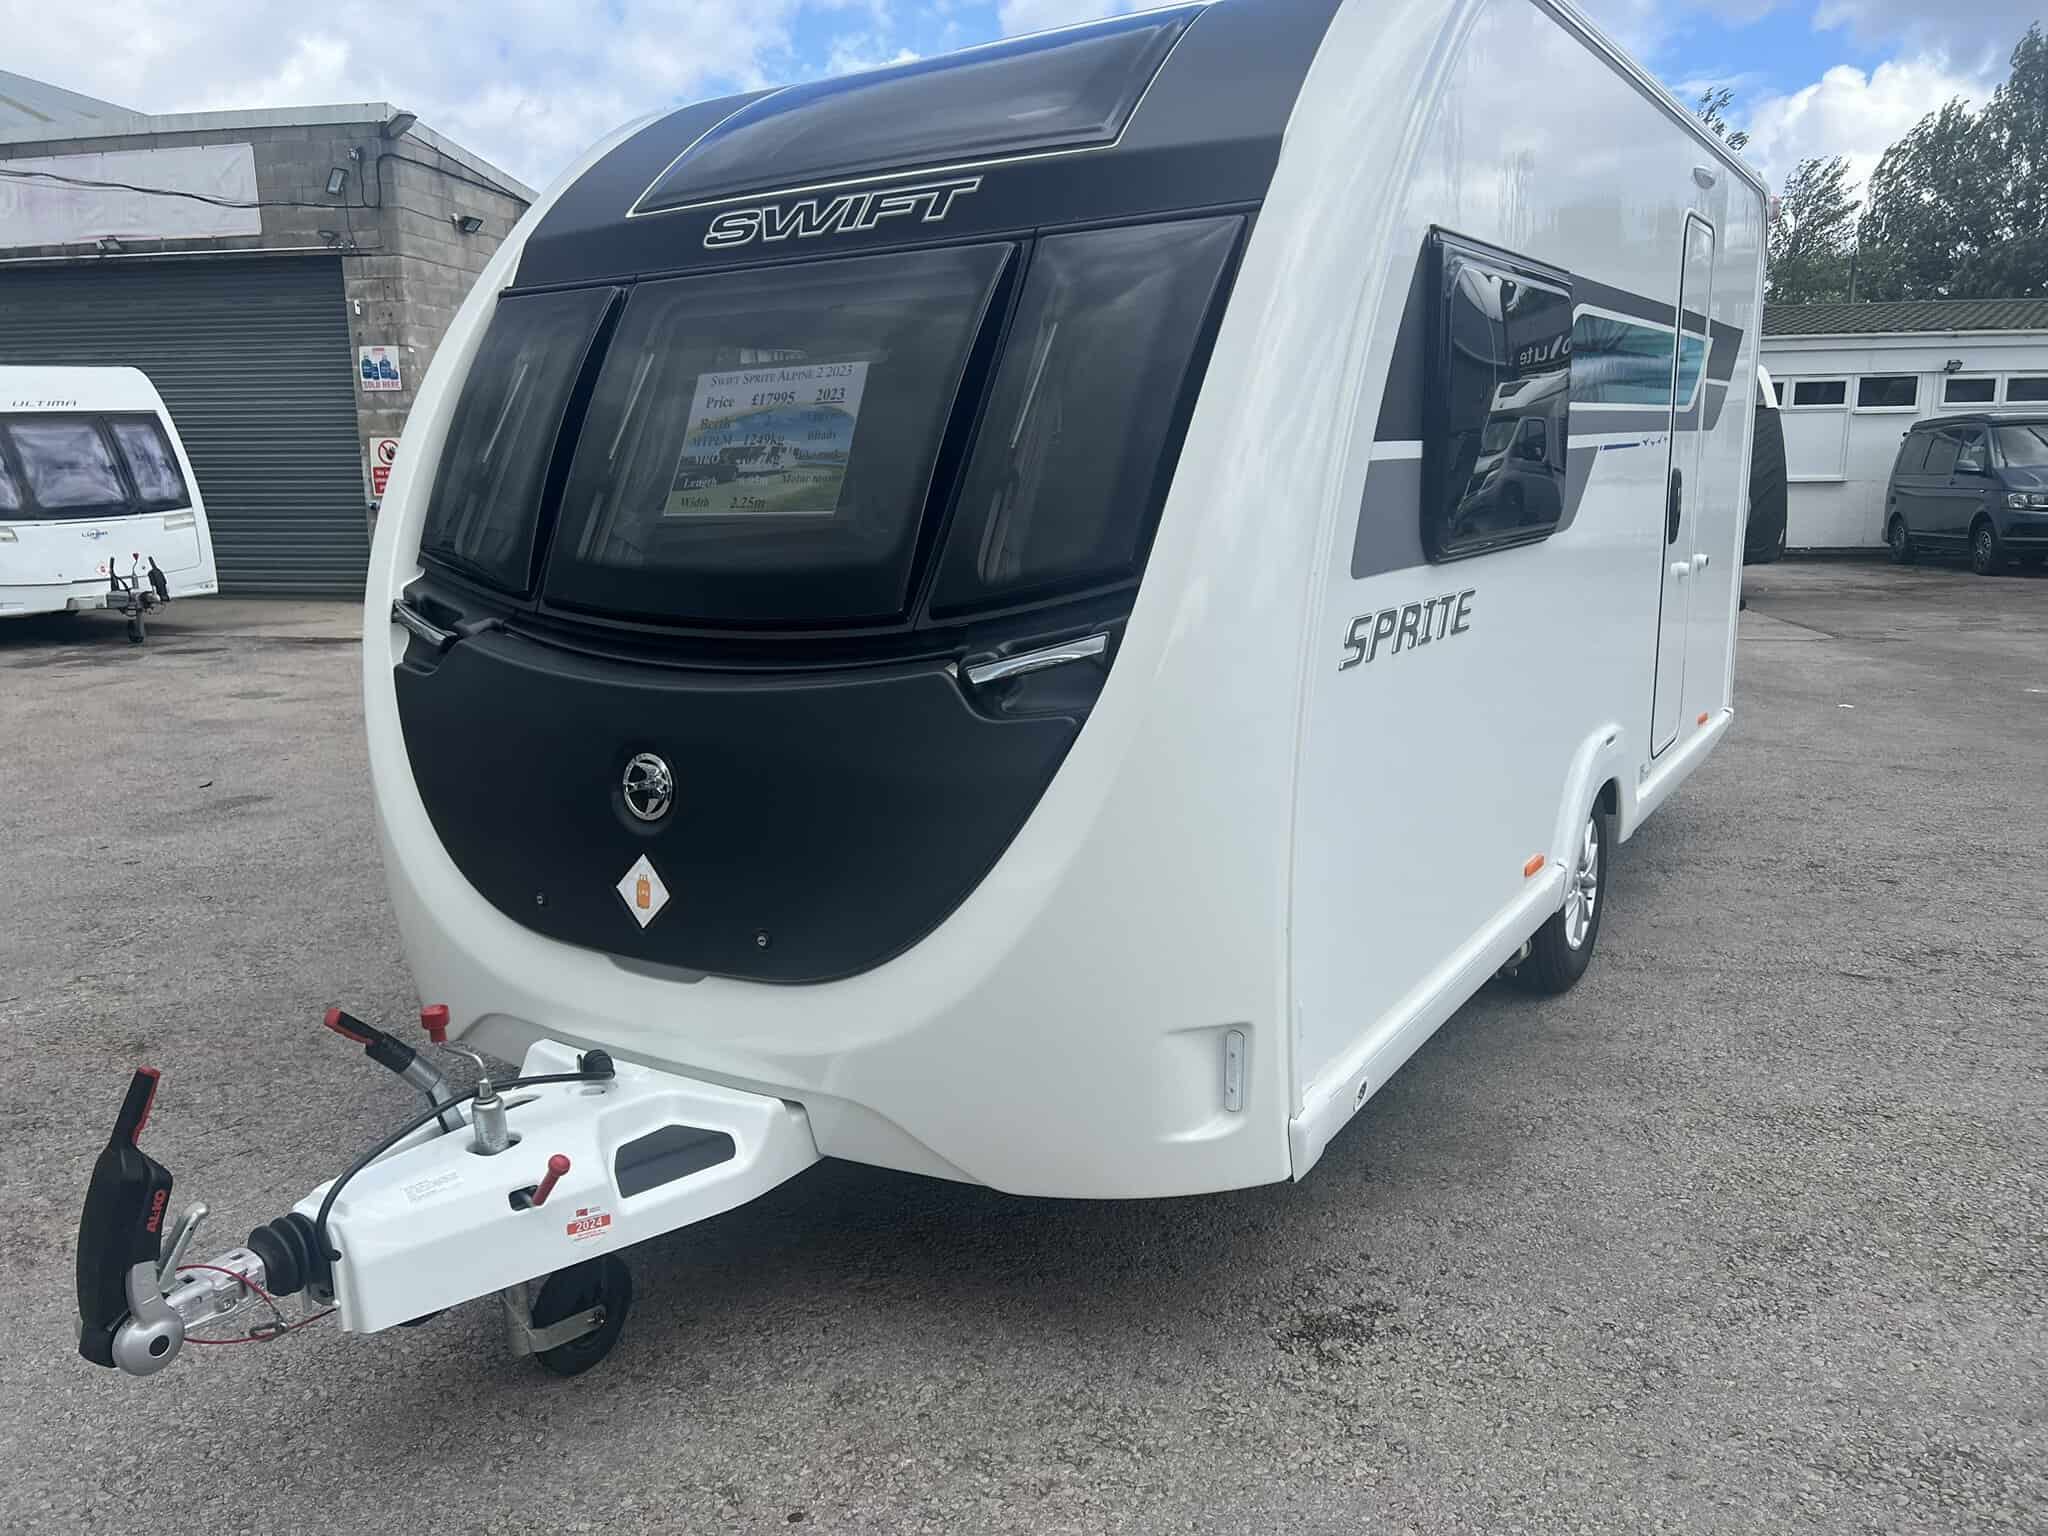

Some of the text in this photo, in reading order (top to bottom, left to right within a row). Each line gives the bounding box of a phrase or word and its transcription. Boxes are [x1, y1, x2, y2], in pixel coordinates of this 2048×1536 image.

[703, 175, 984, 249] SWIFT
[706, 387, 846, 409] Price £17995 2023
[1338, 587, 1476, 671] SPRITE
[575, 1216, 603, 1233] 2024
